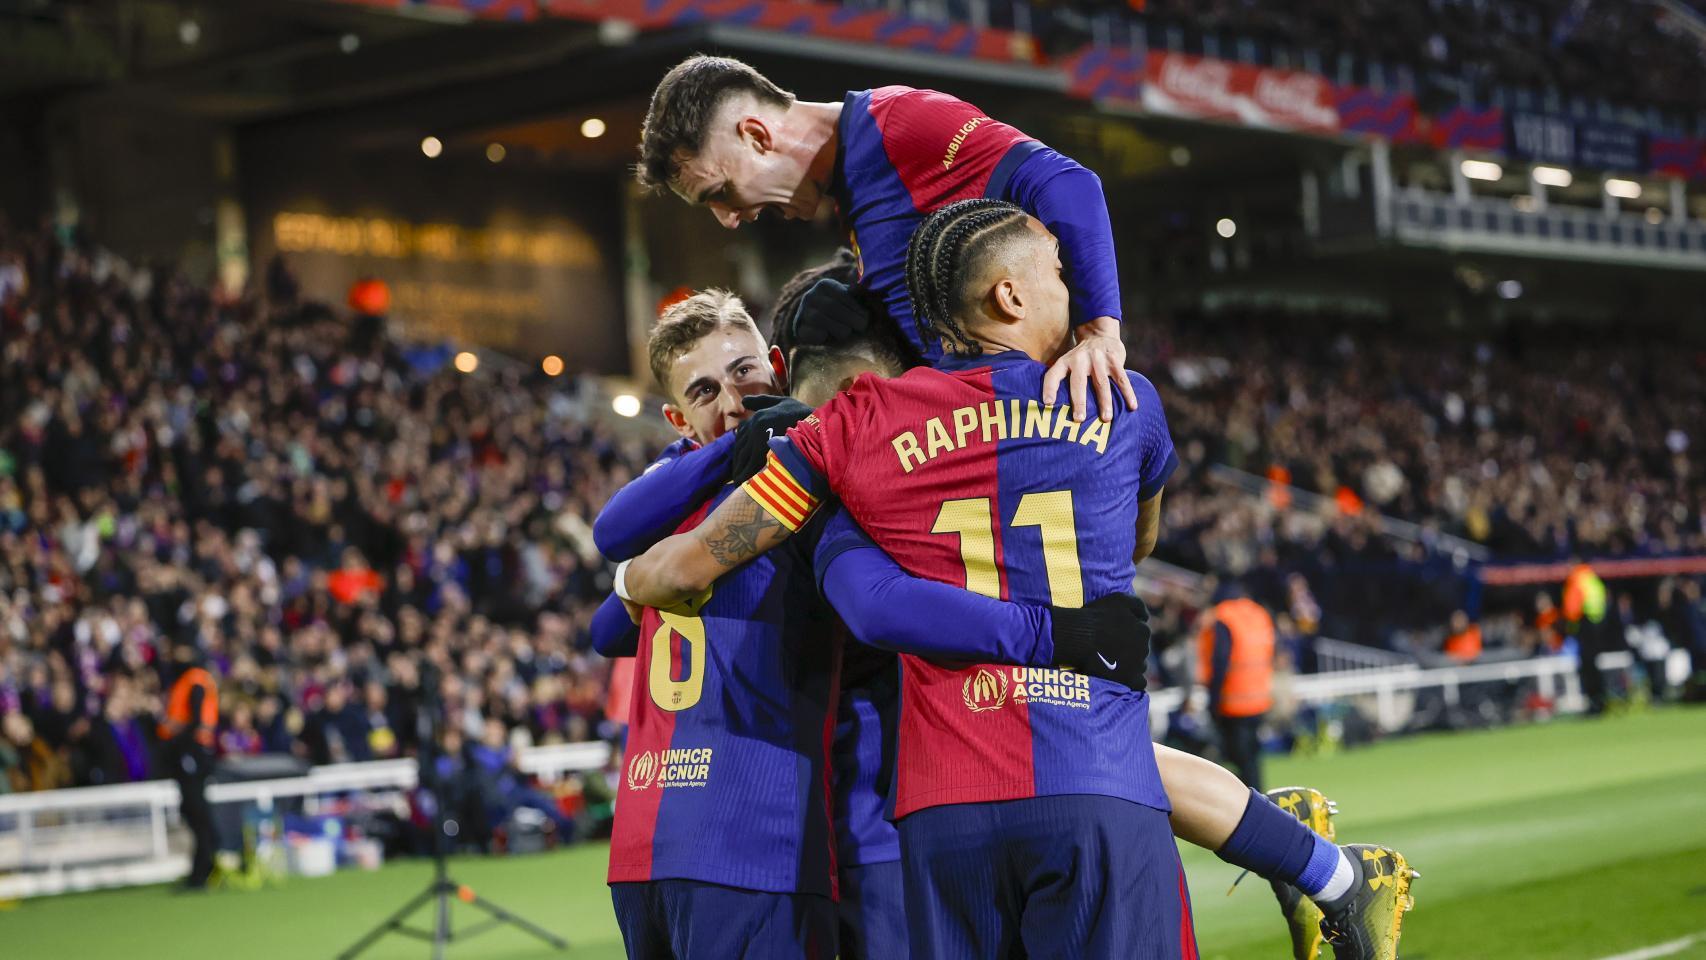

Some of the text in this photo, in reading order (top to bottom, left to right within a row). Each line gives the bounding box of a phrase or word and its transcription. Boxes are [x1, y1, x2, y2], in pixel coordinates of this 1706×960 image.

[892, 400, 1112, 473] RAPHINHA
[931, 490, 1083, 608] 11
[649, 583, 713, 712] 8
[1012, 668, 1089, 688] UNHCR
[1013, 684, 1091, 702] ACNUR
[1039, 697, 1065, 706] Refugee
[1066, 700, 1090, 709] Agency
[661, 748, 713, 766] UNHCR
[657, 765, 709, 781] ACNUR
